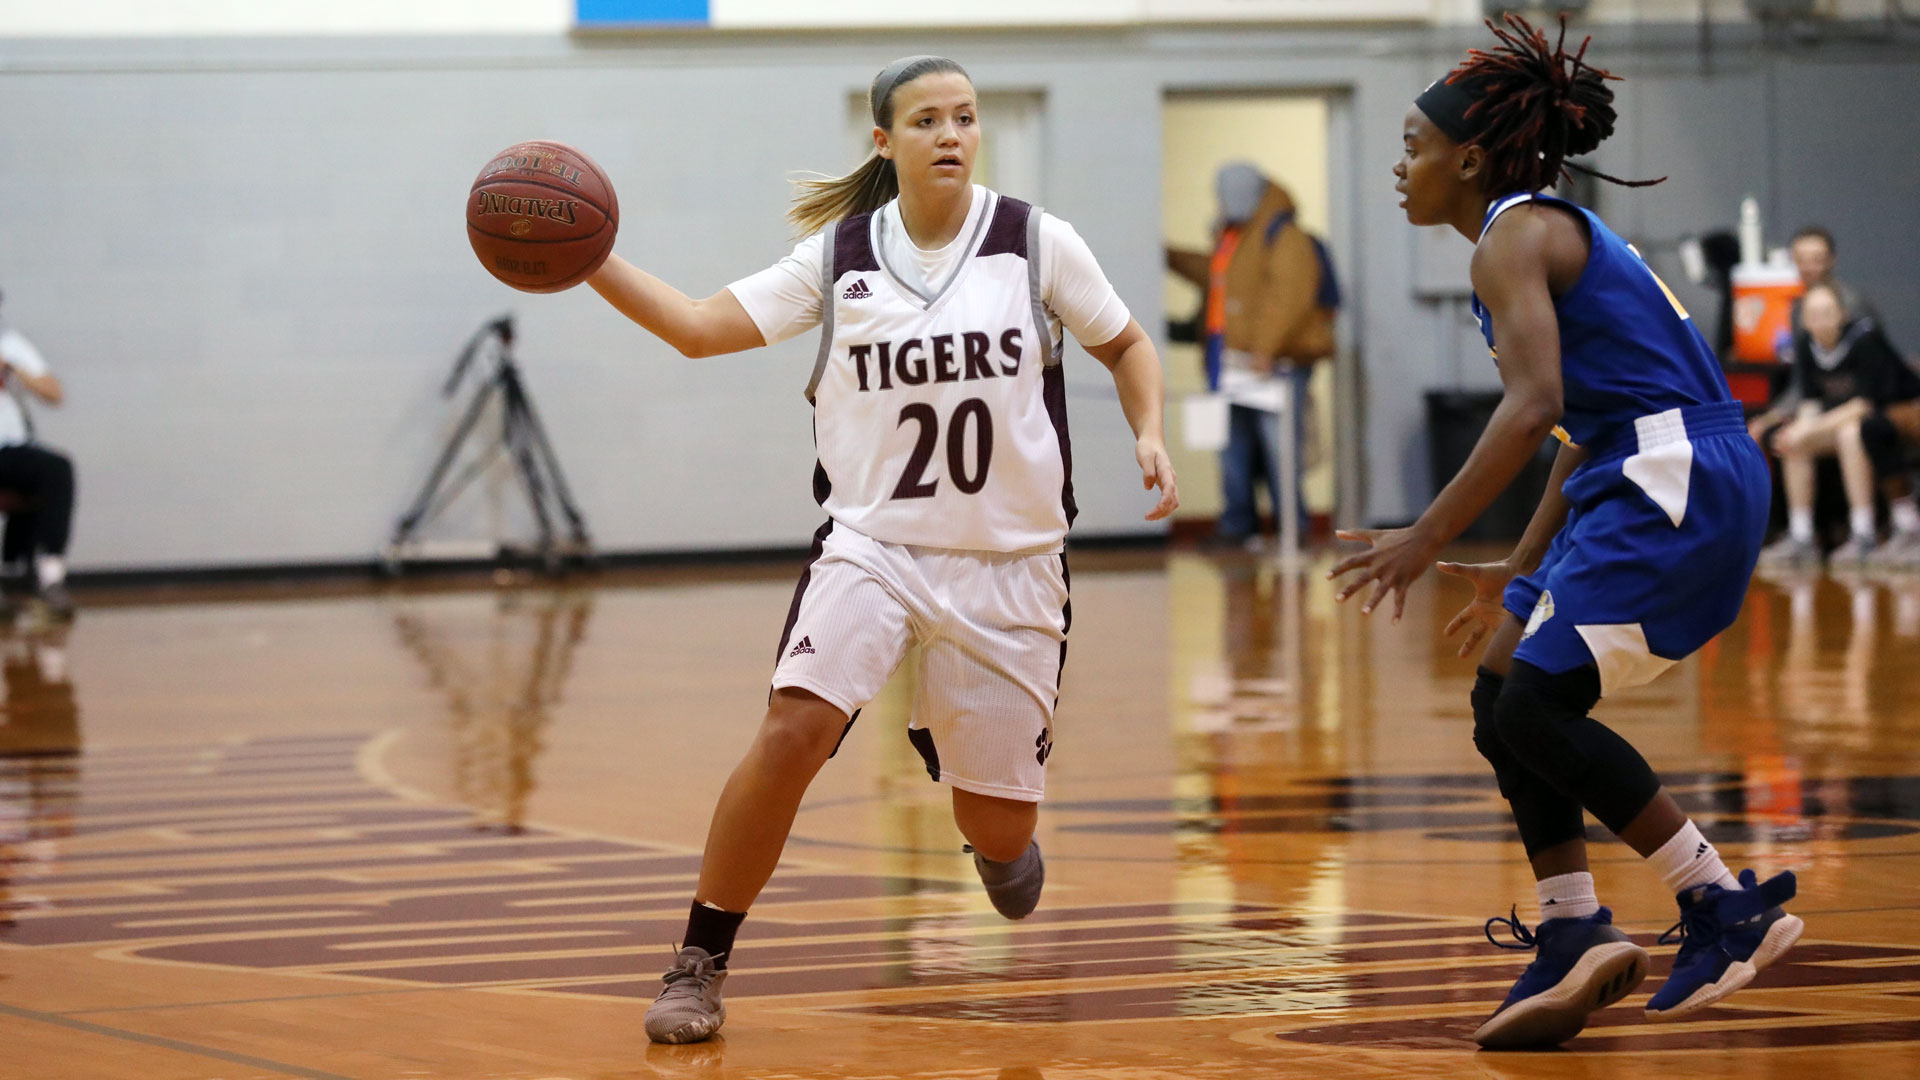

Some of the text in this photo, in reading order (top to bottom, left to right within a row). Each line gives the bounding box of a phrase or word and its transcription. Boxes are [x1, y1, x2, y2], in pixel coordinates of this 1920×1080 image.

[478, 191, 578, 226] SPALDING
[843, 291, 873, 299] adidas
[848, 328, 1024, 392] TIGERS
[889, 397, 994, 501] 20
